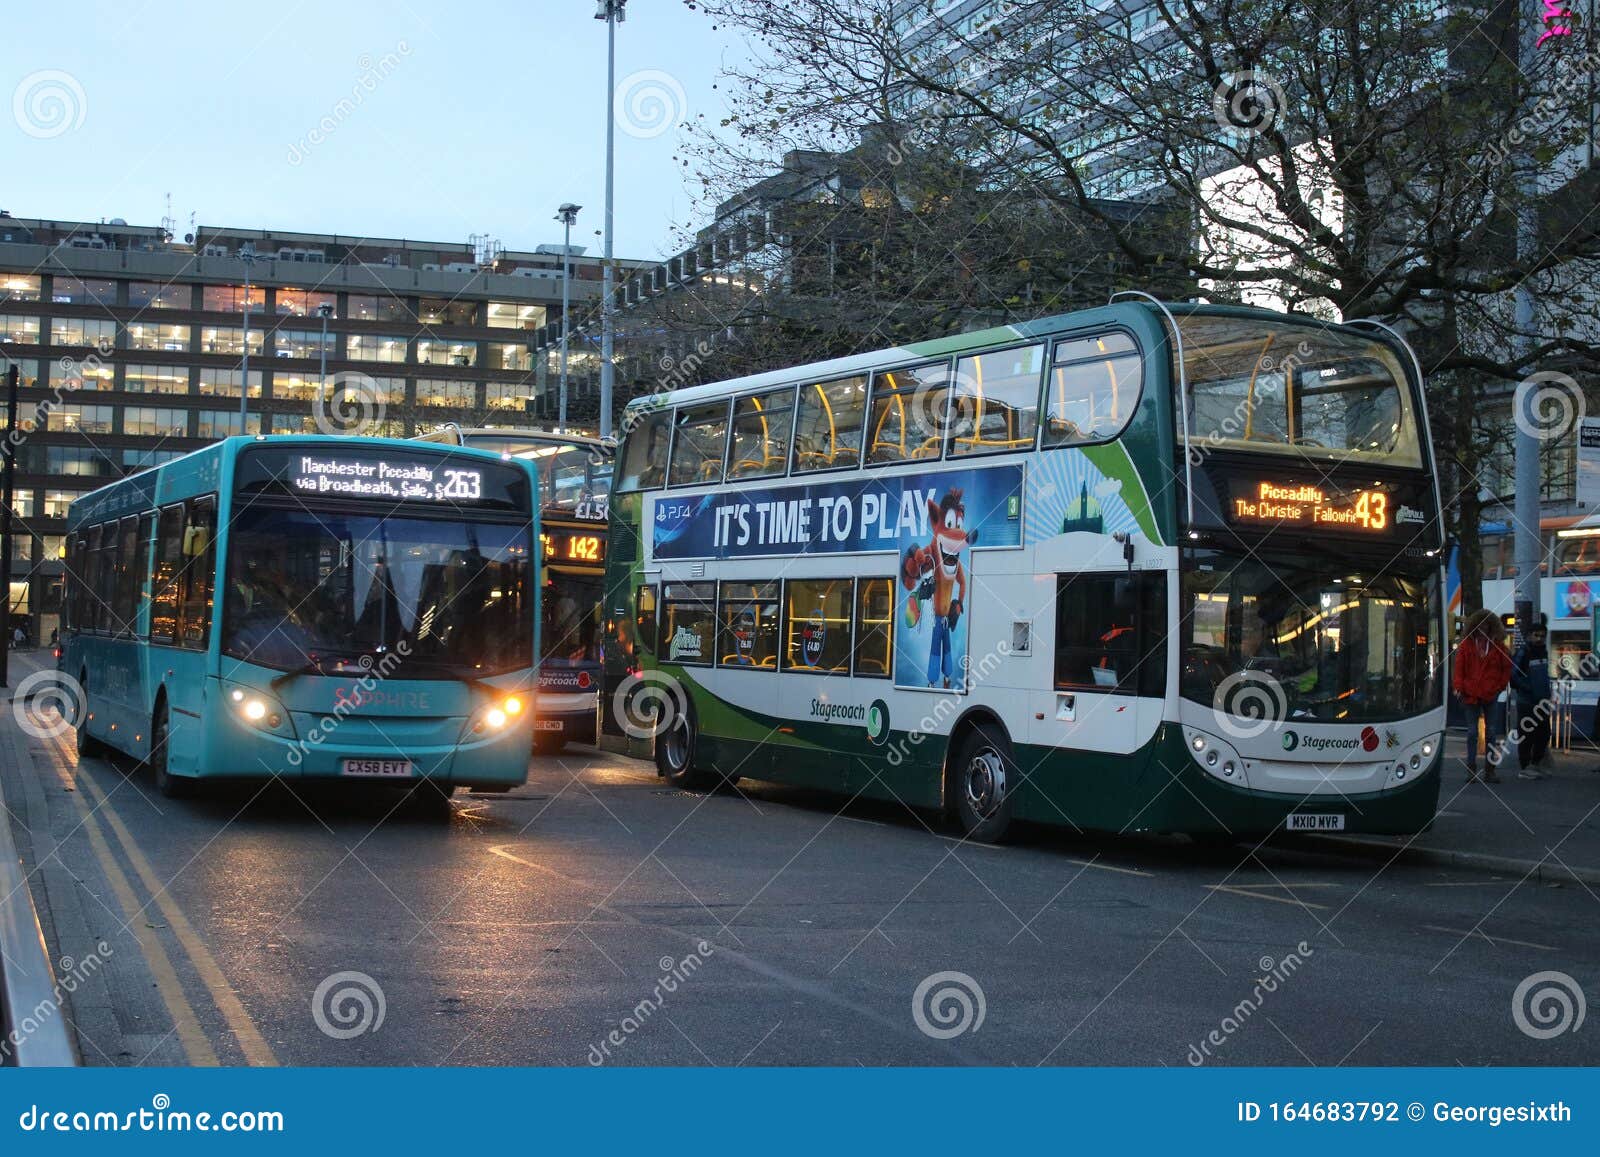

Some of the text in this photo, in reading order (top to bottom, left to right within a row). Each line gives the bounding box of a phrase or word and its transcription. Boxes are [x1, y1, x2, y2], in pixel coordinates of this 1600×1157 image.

[302, 456, 433, 482] Manchester Piccadilly
[296, 478, 317, 490] via
[319, 475, 399, 497] Broadheath,
[401, 480, 433, 499] Sale,
[443, 469, 481, 499] 263
[1260, 483, 1322, 504] Piccadilly
[668, 504, 691, 518] PS4
[1010, 498, 1016, 514] 3
[1236, 500, 1257, 518] The
[1259, 502, 1301, 520] Christie
[1355, 492, 1386, 529] 43
[714, 488, 936, 547] IT'S TIME TO PLAY
[569, 536, 598, 559] 142
[810, 698, 865, 721] Stagecoach
[1301, 735, 1360, 751] Stagecoach
[347, 761, 406, 773] CX58 EVT
[1318, 816, 1338, 828] MVR
